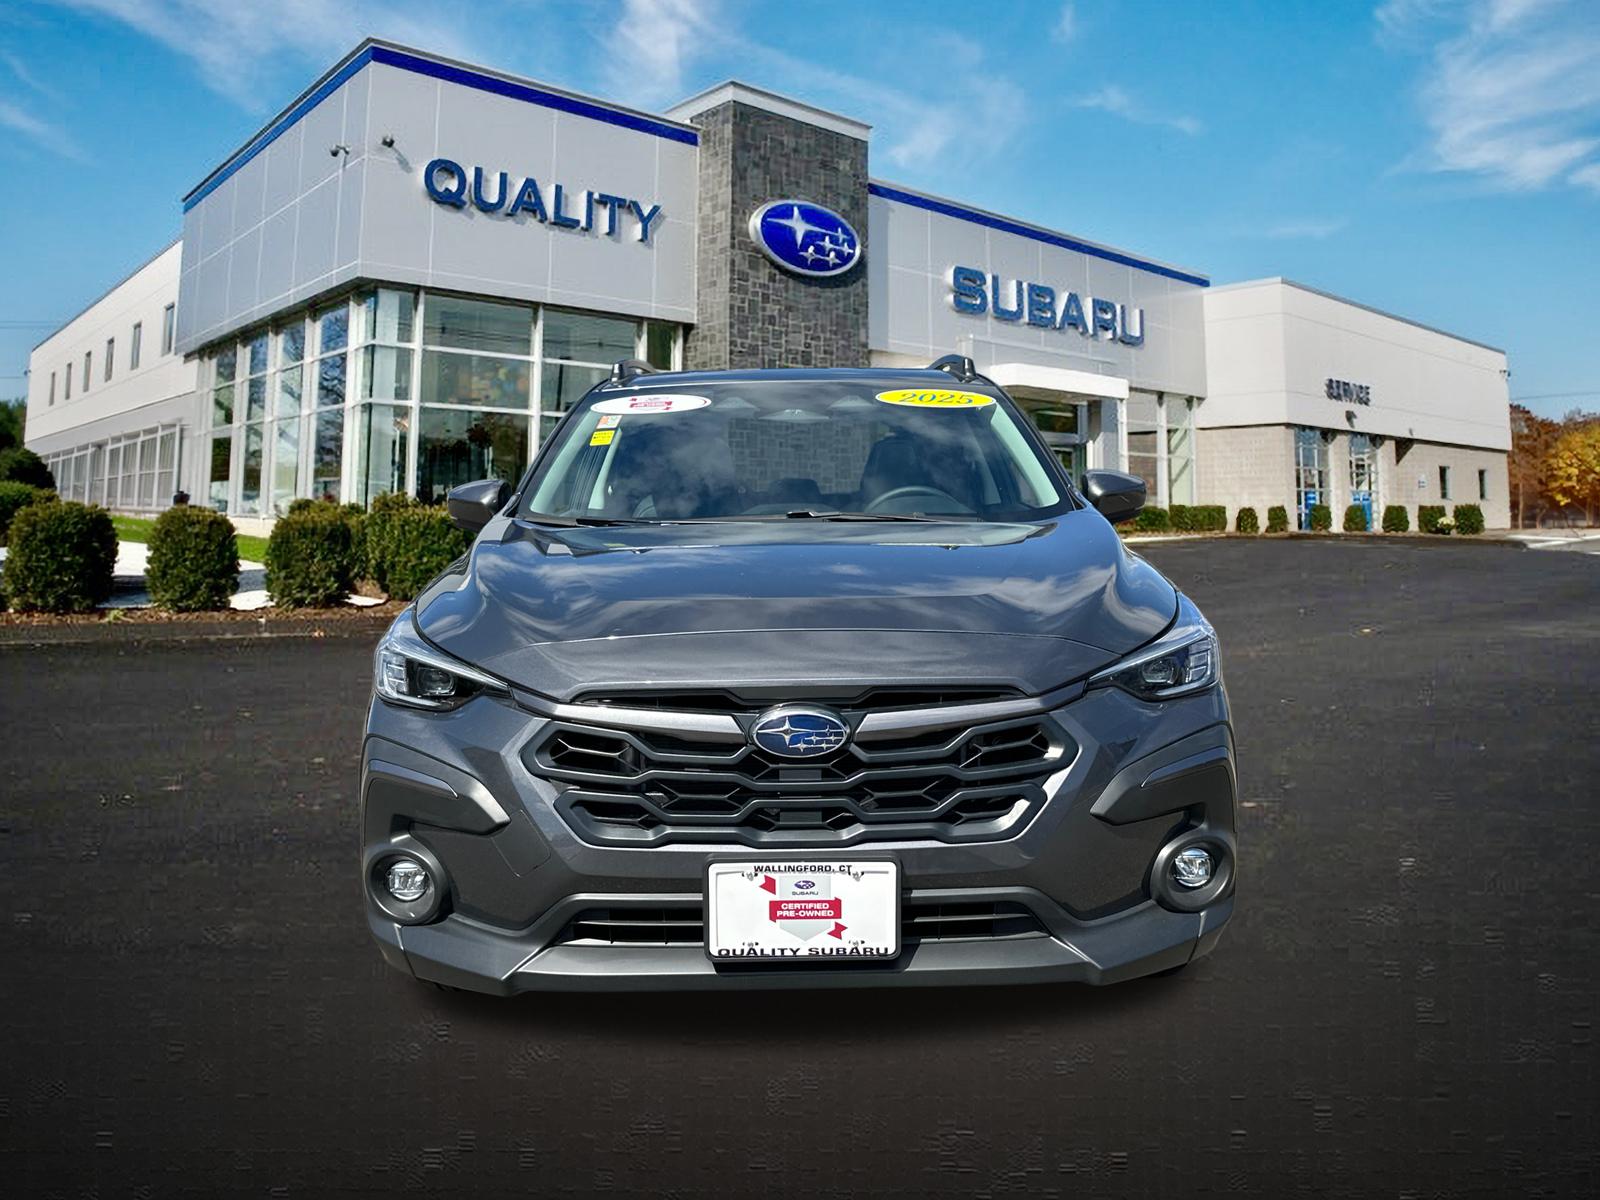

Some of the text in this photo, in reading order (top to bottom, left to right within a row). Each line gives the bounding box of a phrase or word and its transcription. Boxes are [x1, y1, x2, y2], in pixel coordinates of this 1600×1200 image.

[424, 158, 661, 243] QUALITY
[950, 265, 1145, 347] SUBARU
[1325, 378, 1371, 406] SERVICE
[899, 392, 975, 405] 2025
[838, 864, 853, 874] CT
[781, 902, 830, 910] CERTIFIED
[776, 909, 835, 918] PRE-OWNED
[717, 947, 889, 957] QUALITY SUBARU
